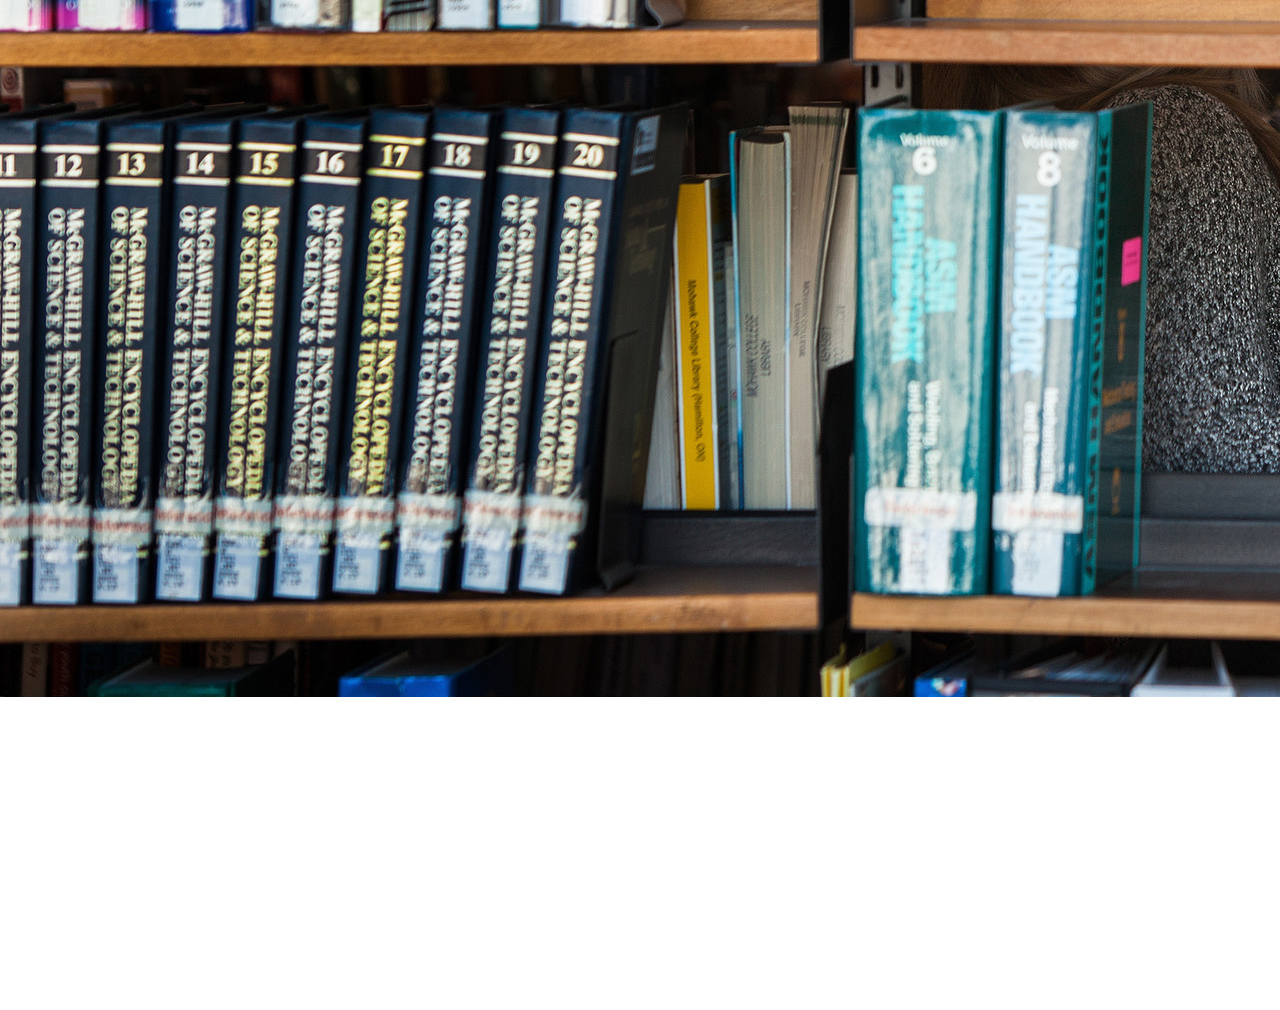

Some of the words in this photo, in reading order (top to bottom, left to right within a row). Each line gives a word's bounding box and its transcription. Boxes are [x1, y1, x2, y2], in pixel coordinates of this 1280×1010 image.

[54, 154, 83, 177] 12
[187, 152, 215, 175] 14
[444, 143, 471, 167] 18
[573, 143, 604, 167] 20
[911, 148, 938, 176] 6
[1037, 152, 1062, 188] 8
[563, 195, 584, 226] OF
[553, 227, 580, 317] SCIENCE
[569, 198, 602, 337] McGRAW-HILL
[1009, 194, 1050, 375] HANDBOOK
[1045, 244, 1079, 320] ASM
[687, 279, 699, 318] Mohawk
[551, 318, 569, 338] &
[688, 320, 700, 357] College
[691, 357, 701, 389] Library
[552, 339, 588, 495] ENCYCLOPEDIA
